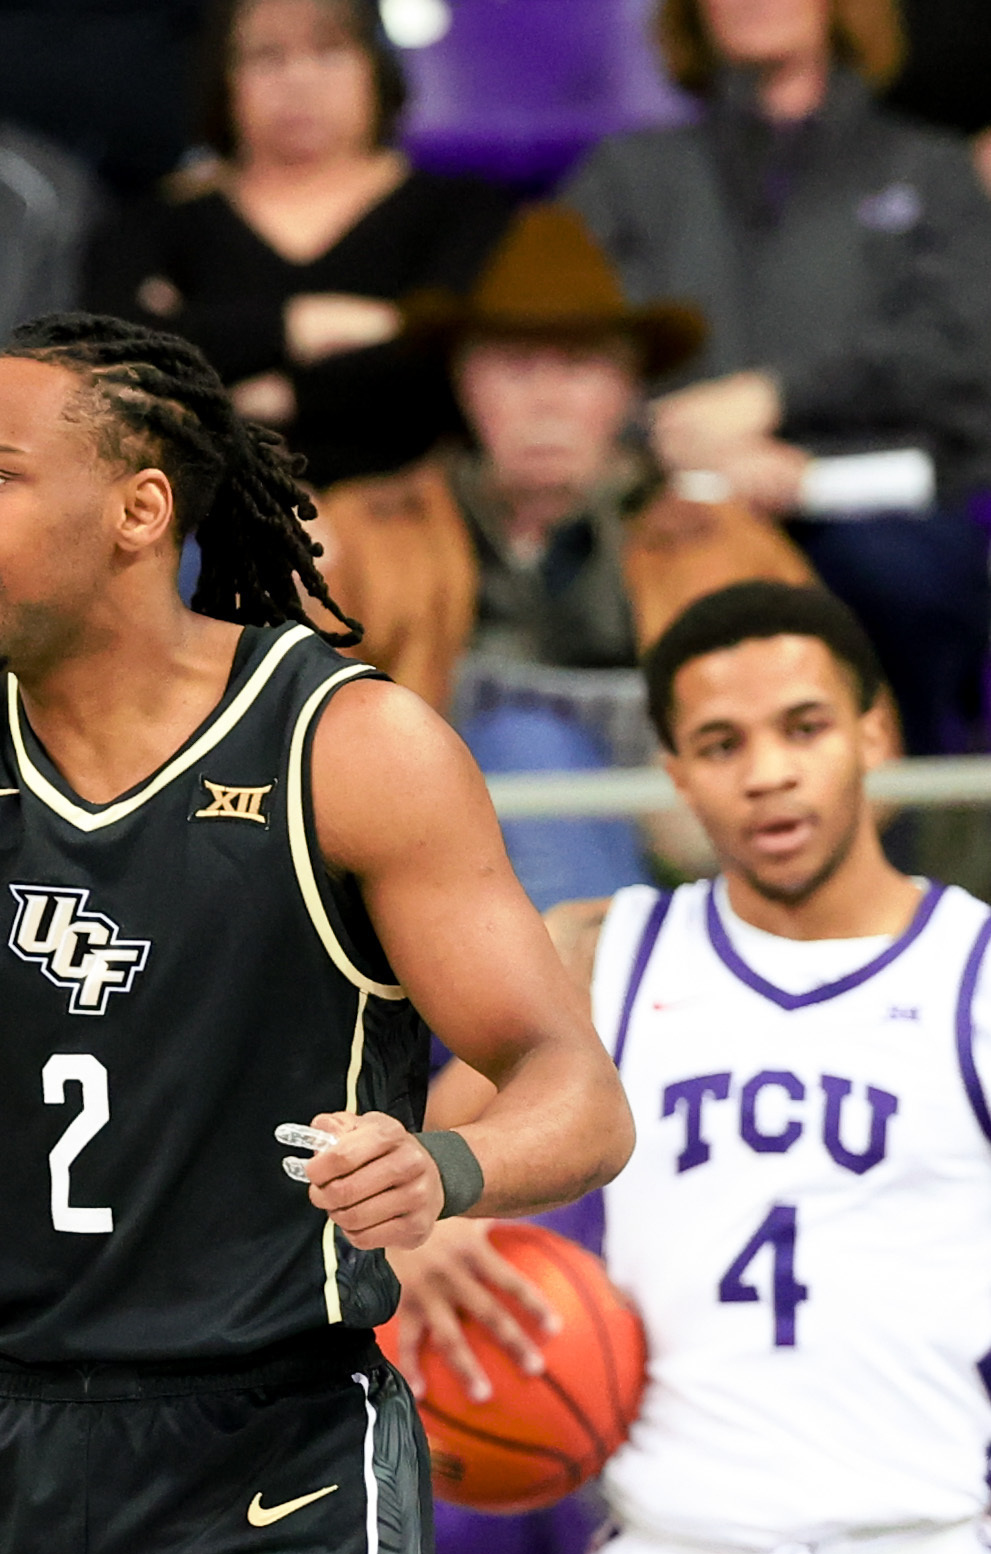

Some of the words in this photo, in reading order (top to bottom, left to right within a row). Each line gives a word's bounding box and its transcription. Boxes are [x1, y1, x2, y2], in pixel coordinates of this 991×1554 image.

[195, 779, 272, 823] XII
[10, 886, 149, 1014] UCF
[42, 1054, 113, 1233] 2
[660, 1070, 899, 1175] TCU
[719, 1206, 809, 1346] 4
